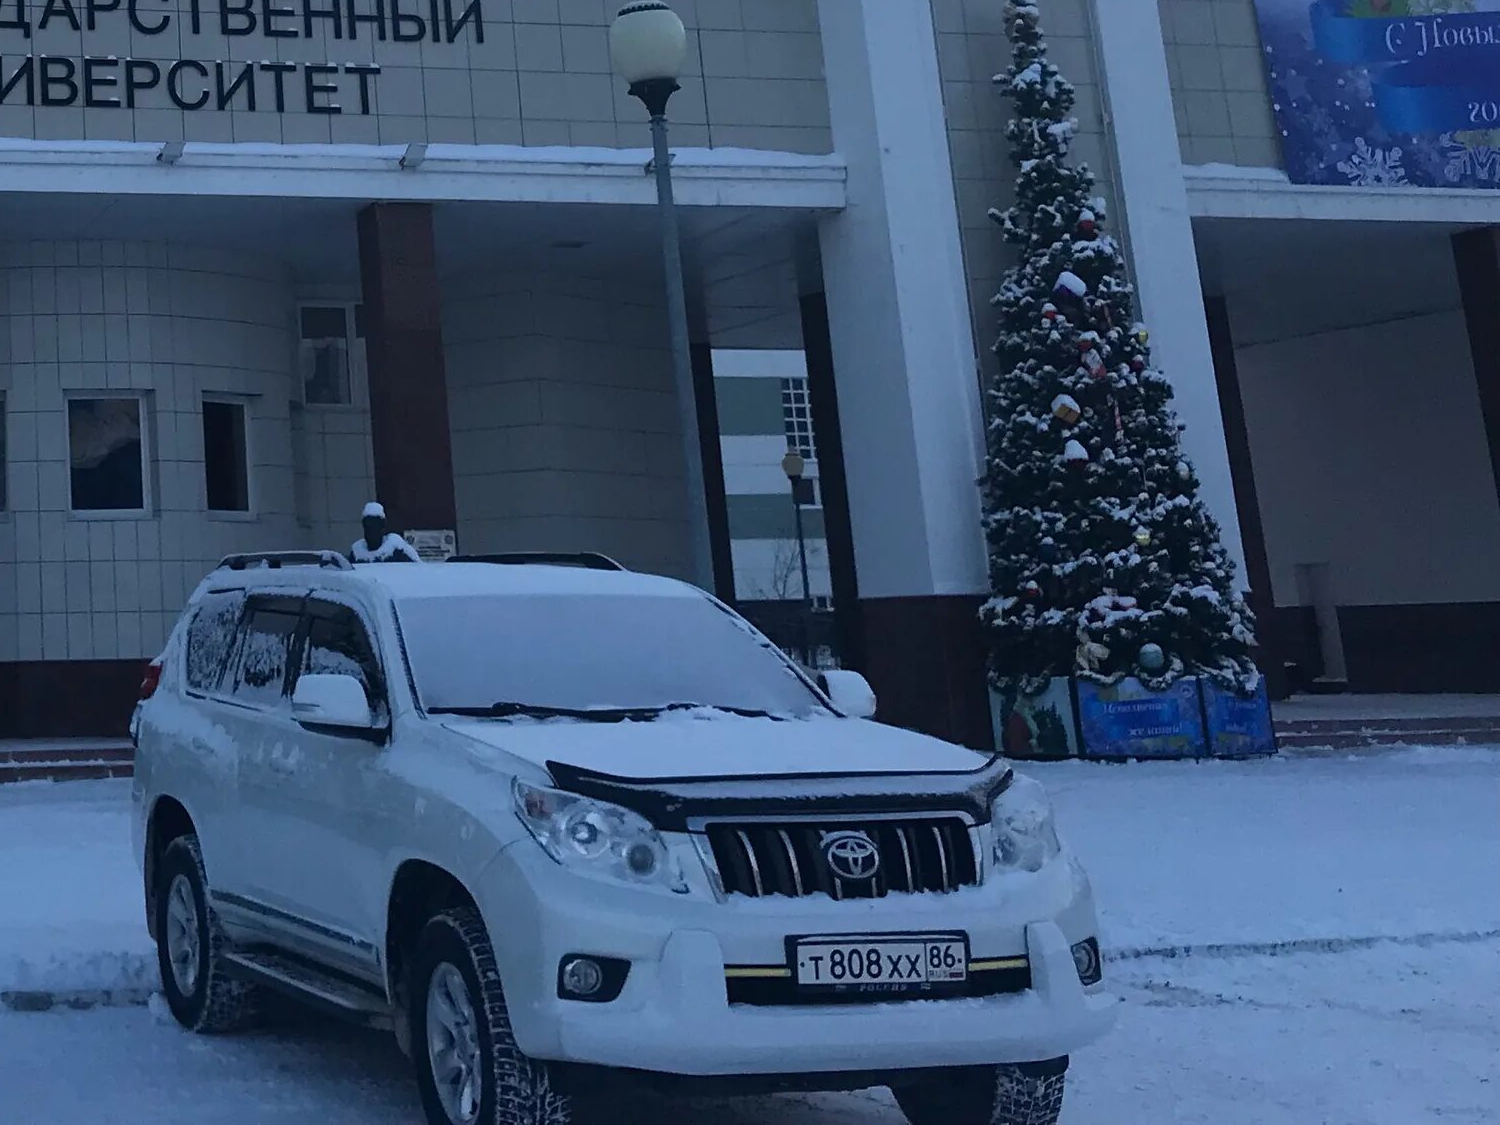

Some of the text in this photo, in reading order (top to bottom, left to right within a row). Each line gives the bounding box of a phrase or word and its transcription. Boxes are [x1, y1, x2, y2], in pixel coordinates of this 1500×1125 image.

[1414, 18, 1500, 56] Новы
[1467, 101, 1500, 123] 20
[929, 945, 957, 969] 86
